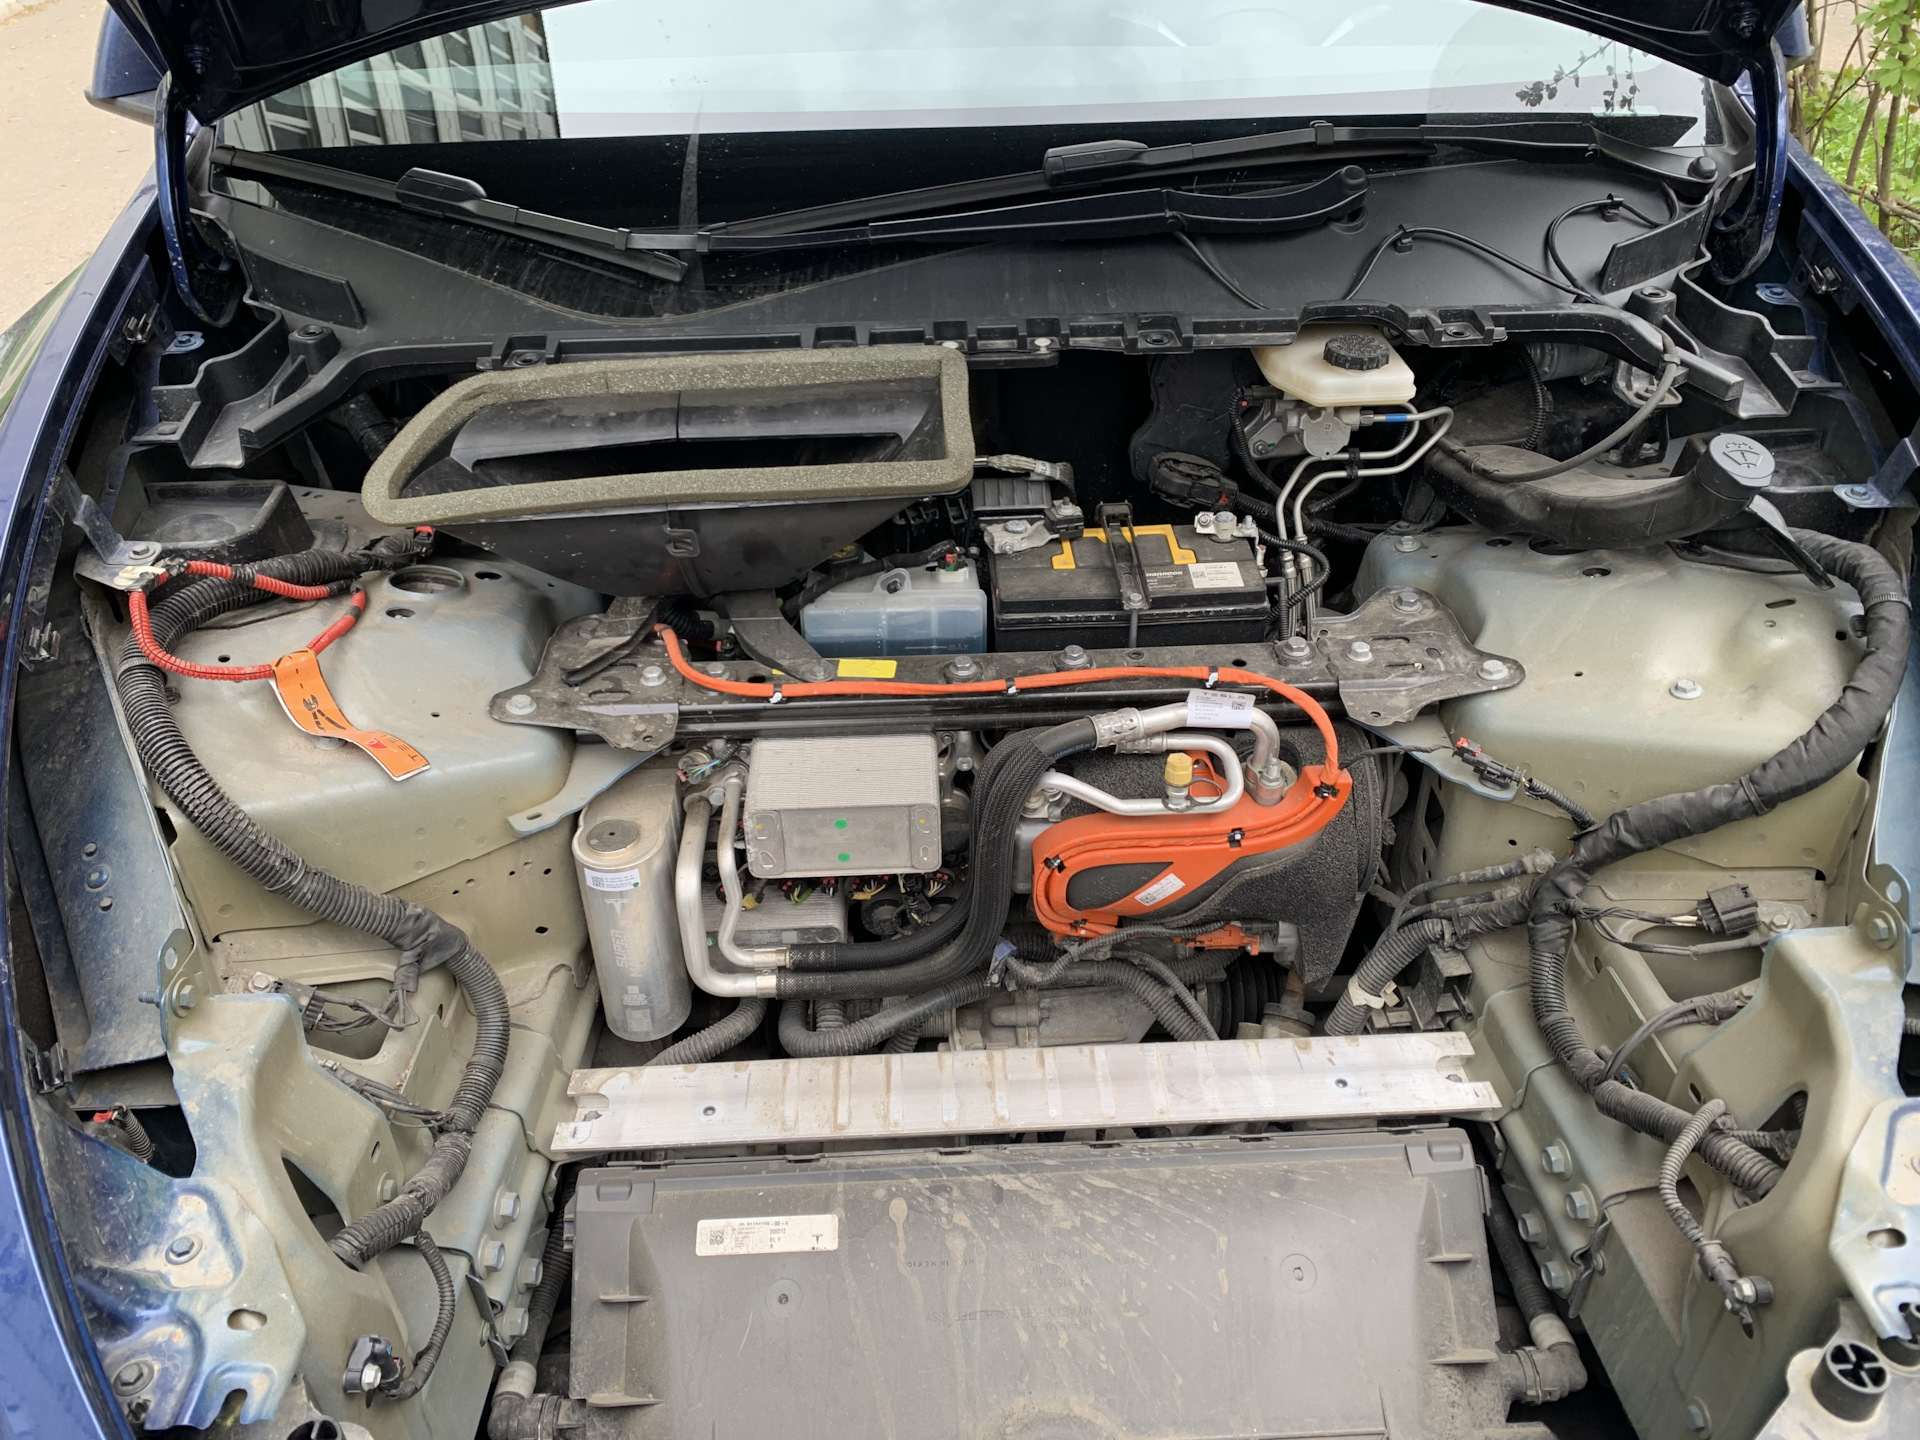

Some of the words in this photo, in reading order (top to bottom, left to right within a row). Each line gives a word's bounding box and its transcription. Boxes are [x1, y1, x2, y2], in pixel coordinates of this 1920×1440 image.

[1202, 691, 1245, 699] TESLA
[610, 929, 628, 968] SUPER
[940, 1259, 949, 1267] IN
